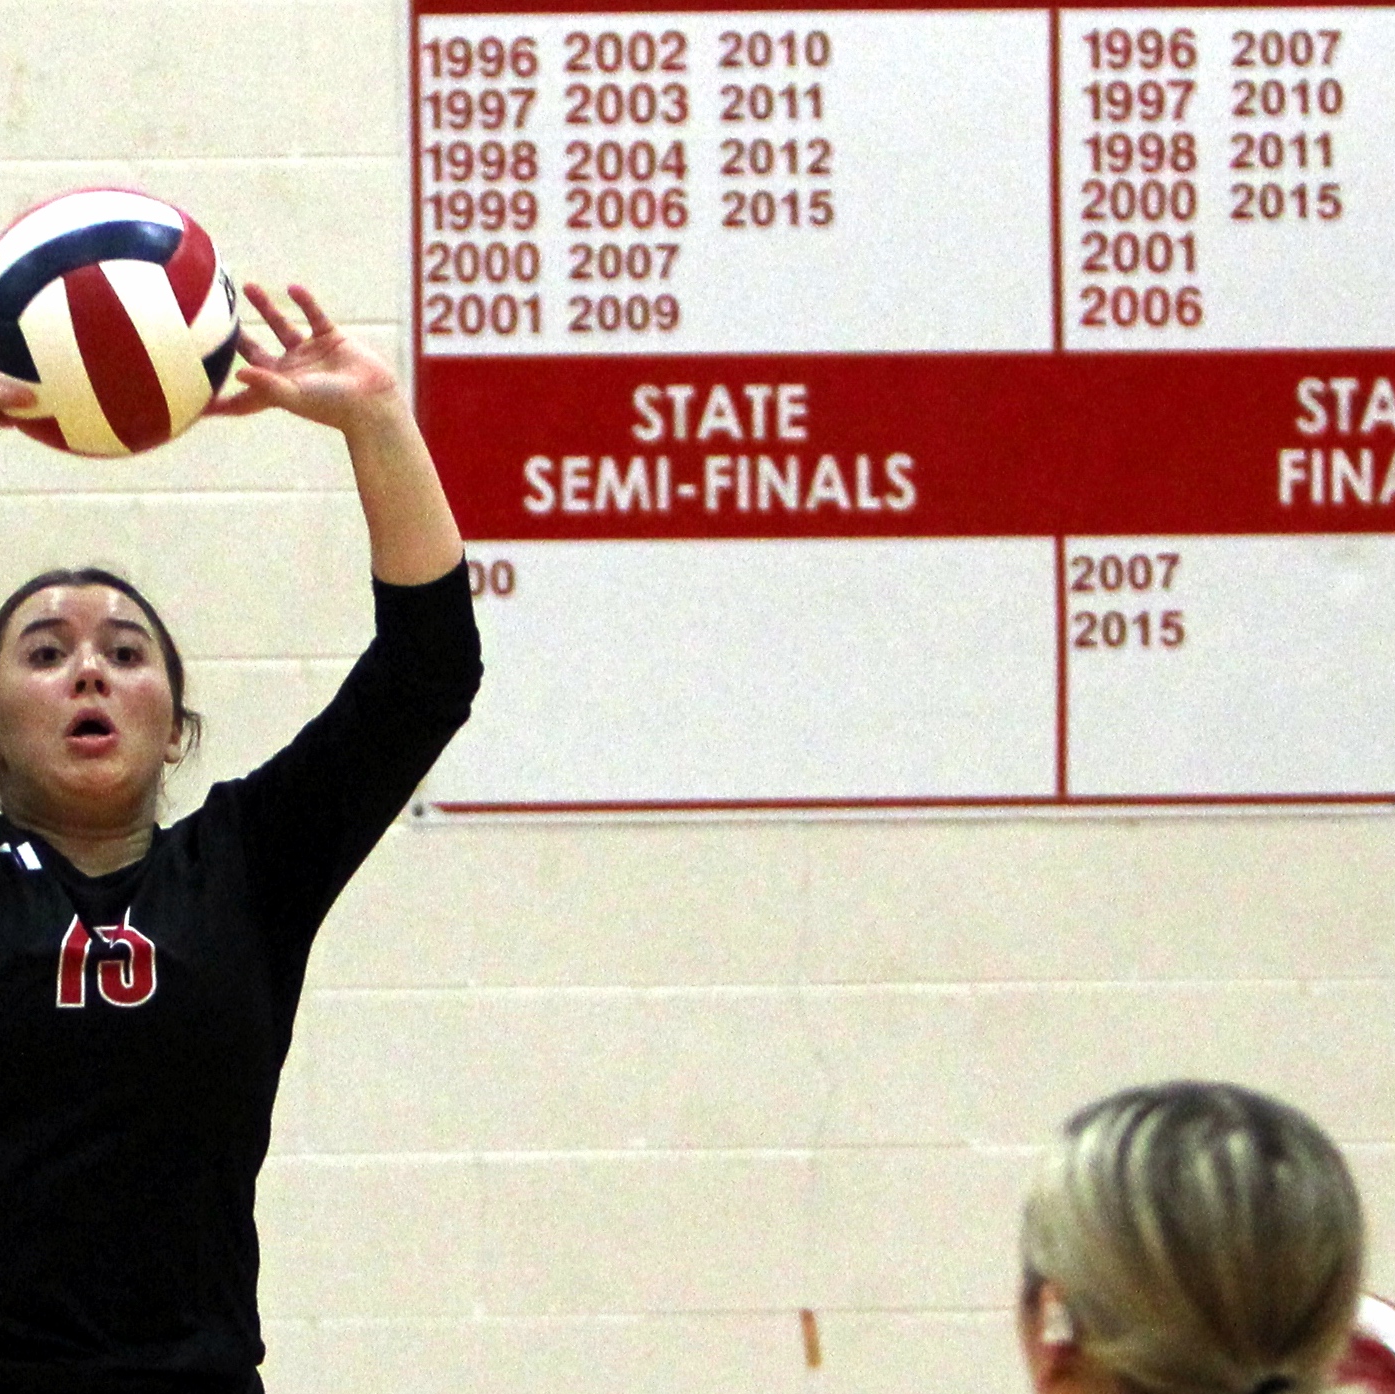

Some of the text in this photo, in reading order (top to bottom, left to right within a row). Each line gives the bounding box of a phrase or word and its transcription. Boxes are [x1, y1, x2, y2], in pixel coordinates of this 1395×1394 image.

[423, 30, 831, 80] 1996 2002 2010
[1083, 28, 1341, 71] 1996 2007
[422, 83, 822, 131] 1997 2003 2011
[1084, 78, 1344, 123] 1997 2010
[424, 138, 832, 183] 1998 2004 2012
[1086, 131, 1332, 174] 1998 2011
[424, 187, 834, 232] 1999 2006 2015
[1081, 179, 1343, 223] 2000 2015
[425, 242, 680, 284] 2000 2007
[1081, 230, 1195, 274] 2001
[425, 293, 680, 336] 2001 2009
[1080, 285, 1203, 328] 2006
[633, 384, 806, 442] STATE
[524, 453, 916, 514] SEMI-FINALS
[1070, 553, 1180, 593] 2007
[1073, 610, 1185, 649] 2015
